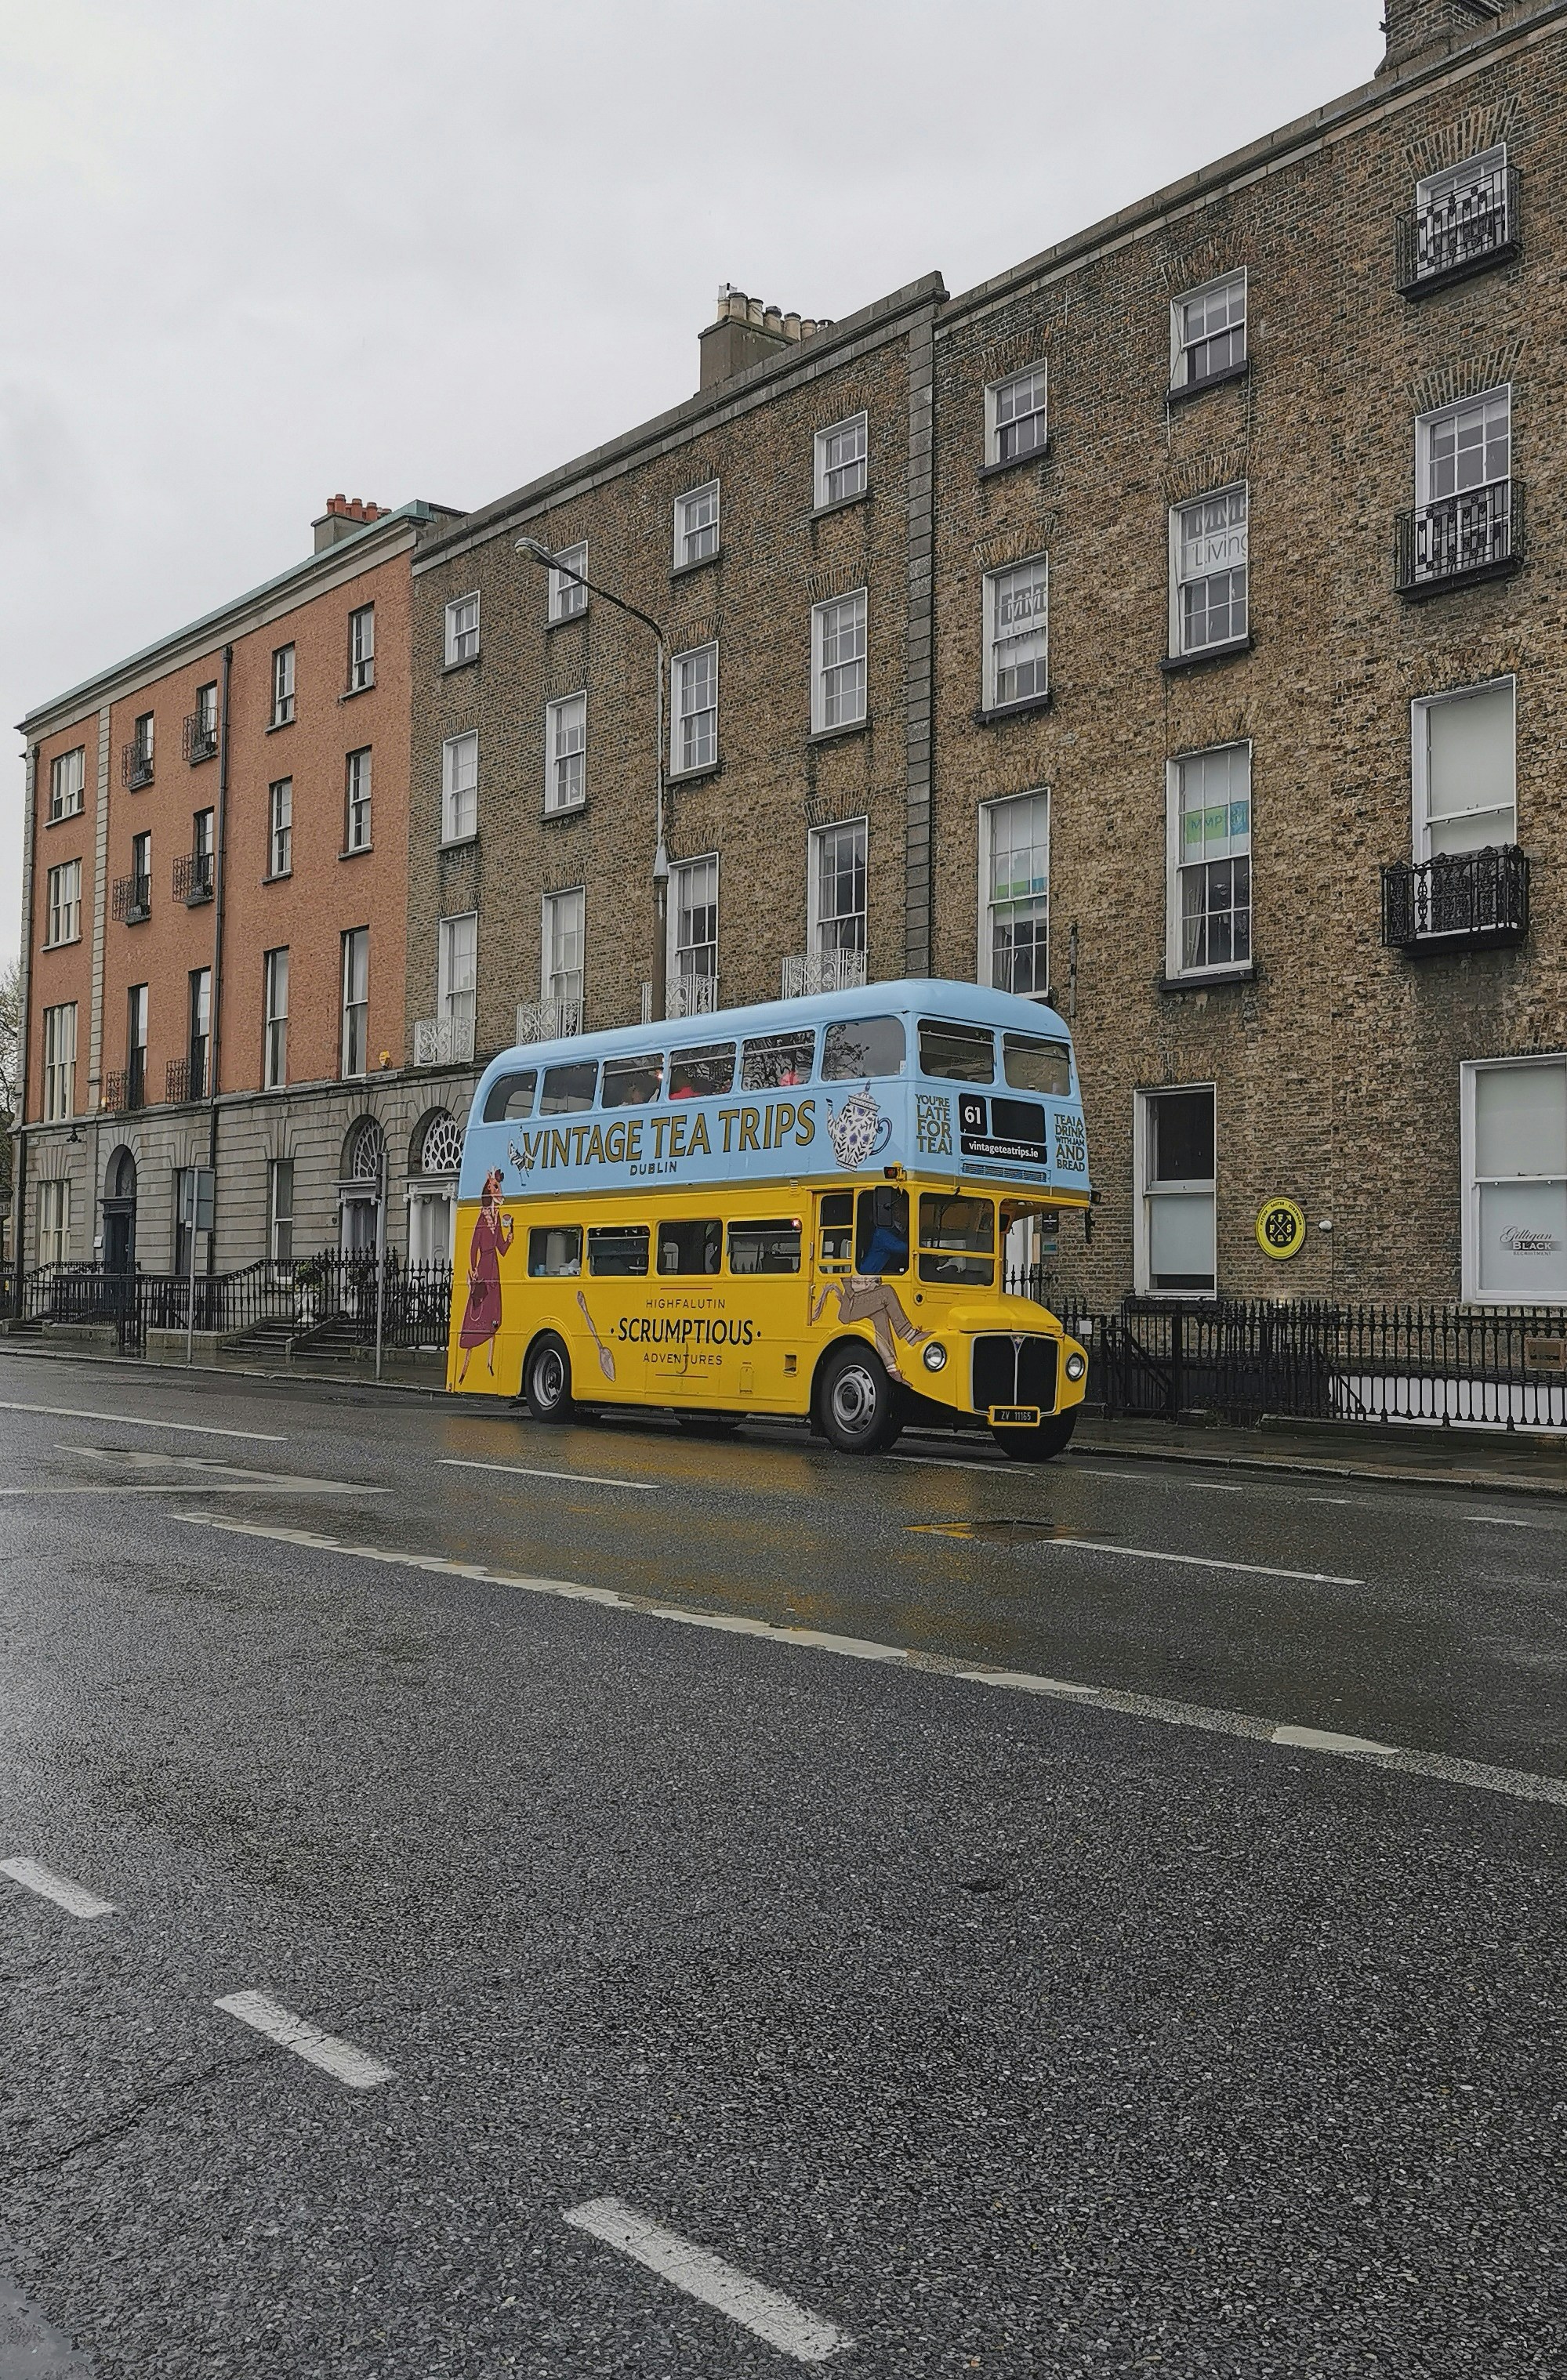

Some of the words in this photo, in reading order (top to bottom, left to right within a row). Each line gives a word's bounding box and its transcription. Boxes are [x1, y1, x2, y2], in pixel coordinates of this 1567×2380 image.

[915, 1093, 950, 1108] YOU'RE
[916, 1104, 951, 1121] LATE
[964, 1106, 981, 1125] 61
[523, 1119, 644, 1170] VINTAGE
[650, 1112, 712, 1159] TEA
[718, 1099, 816, 1153] TRIPS
[917, 1118, 952, 1139] FOR
[1054, 1124, 1085, 1139] DRINK
[916, 1135, 952, 1155] TEA!
[1054, 1135, 1072, 1145] WITH
[1072, 1138, 1085, 1147] JAM
[968, 1140, 1039, 1158] vintageteatrips.ie
[1055, 1143, 1085, 1161] AND
[629, 1161, 677, 1176] DUBLIN
[1056, 1158, 1086, 1172] BREAD
[1286, 1224, 1292, 1233] S
[1500, 1225, 1552, 1244] Gilligan
[1512, 1241, 1551, 1250] BLACK
[646, 1299, 726, 1310] HIGHFALUTIN
[618, 1317, 753, 1346] SCRUMPTIOUS
[643, 1353, 723, 1365] ADVENTURES
[1000, 1411, 1010, 1420] ZV
